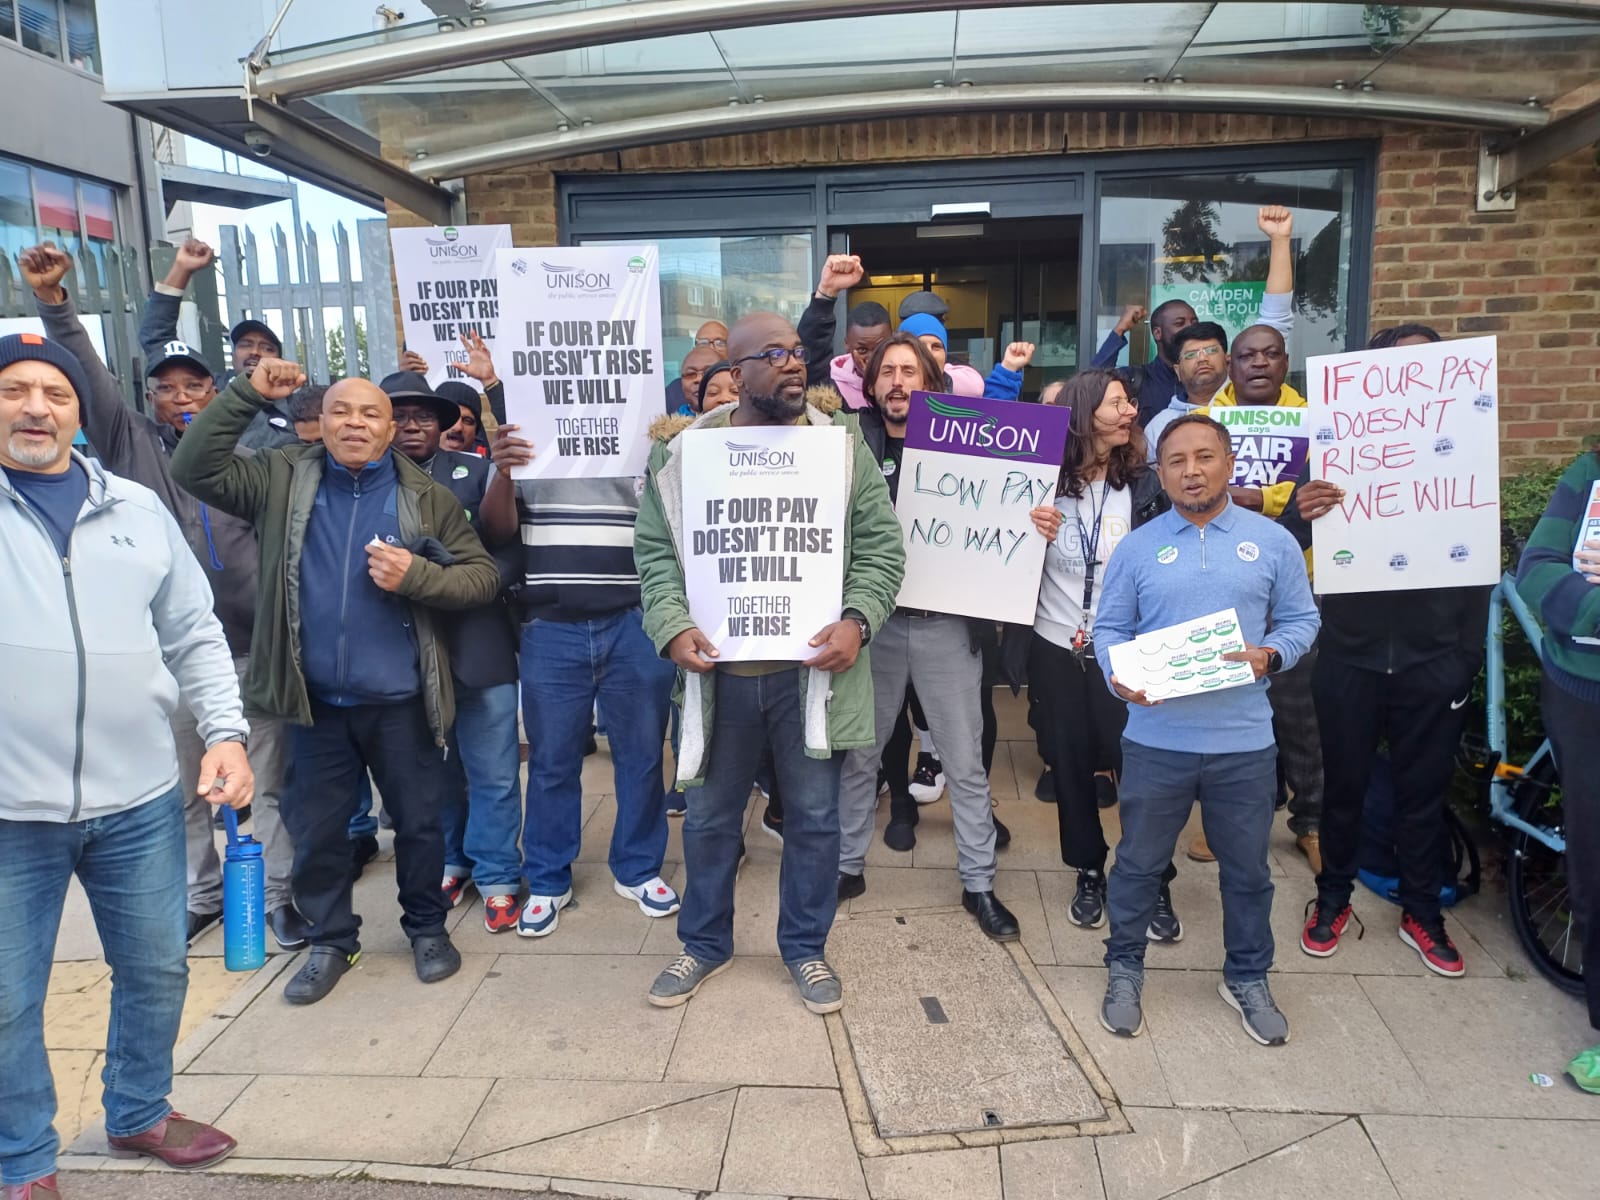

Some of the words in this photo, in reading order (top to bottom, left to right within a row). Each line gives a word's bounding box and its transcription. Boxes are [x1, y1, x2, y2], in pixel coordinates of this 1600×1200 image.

[430, 244, 478, 258] UNISON
[418, 282, 432, 300] IF
[434, 280, 468, 299] OUR
[470, 278, 498, 298] PAY
[546, 273, 610, 288] UNISON
[1190, 288, 1253, 302] CAMDEN
[409, 301, 474, 321] DOESN'T
[1194, 304, 1224, 316] CLE
[1228, 302, 1261, 314] POU
[433, 323, 456, 342] WE
[458, 322, 496, 340] WILL
[526, 321, 544, 346] IF
[550, 320, 593, 346] OUR
[597, 320, 636, 346] PAY
[444, 350, 468, 364] TOGE
[513, 349, 601, 376] DOESN'T
[606, 349, 653, 375] RISE
[543, 380, 574, 404] WE
[577, 379, 626, 404] WILL
[1323, 361, 1362, 405] IF
[1363, 362, 1433, 399] OUR
[1438, 356, 1493, 392] PAY
[555, 418, 618, 436] TOGETHER
[1220, 410, 1301, 426] UNISON
[1333, 398, 1456, 440] DOESN'T
[558, 438, 580, 456] WE
[584, 437, 620, 456] RISE
[929, 418, 1040, 452] UNISON
[730, 452, 794, 466] UNISON
[1231, 436, 1293, 462] FAIR
[1229, 460, 1286, 484] PAY
[1322, 443, 1416, 480] RISE
[914, 462, 988, 510] LOW
[1001, 472, 1054, 508] PAY
[706, 499, 724, 525] IF
[728, 498, 772, 524] OUR
[777, 498, 818, 524] PAY
[1337, 482, 1404, 524] WE
[1414, 475, 1496, 512] WILL
[693, 526, 779, 556] DOESN'T
[784, 527, 832, 554] RISE
[910, 518, 952, 548] NO
[964, 526, 1030, 566] WAY
[718, 557, 747, 583] WE
[751, 556, 802, 582] WILL
[728, 596, 790, 614] TOGETHER
[728, 617, 749, 637] WE
[753, 616, 790, 636] RISE
